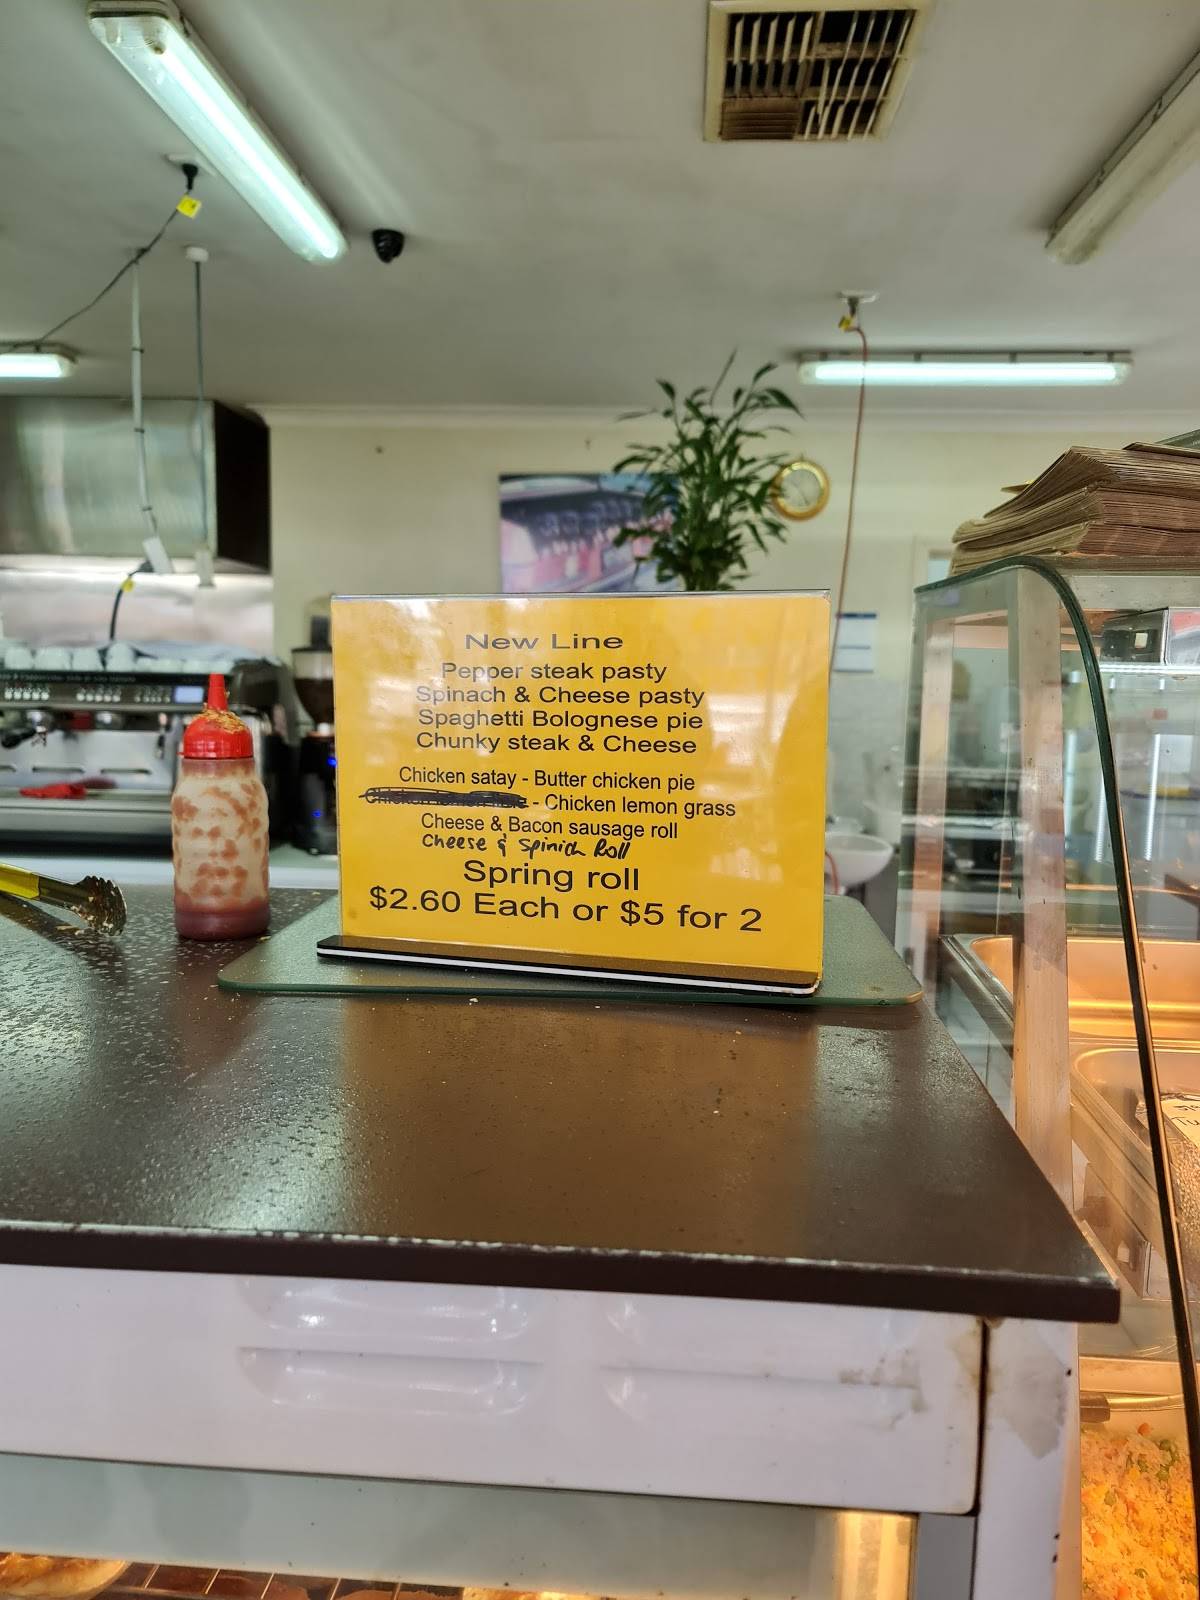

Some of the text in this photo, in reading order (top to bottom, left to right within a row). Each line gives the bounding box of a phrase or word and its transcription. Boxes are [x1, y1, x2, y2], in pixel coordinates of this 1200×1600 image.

[465, 634, 623, 649] New Line
[442, 662, 667, 683] Pepper steak pasty
[416, 686, 705, 708] Spinach & Cheese pasty
[418, 709, 703, 732] Spaghetti Bolognese pie
[416, 732, 697, 753] Chunky steak & Cheese
[399, 766, 465, 784] Chicken
[471, 771, 516, 788] satay
[534, 770, 587, 788] Butter
[592, 772, 661, 790] chicken
[667, 774, 695, 791] pie
[545, 794, 616, 812] Chicken
[622, 797, 678, 815] lemon
[684, 803, 736, 818] grass
[421, 813, 678, 840] Cheese & Bacon sausage roll
[422, 833, 488, 851] Cheese
[593, 838, 631, 860] Roll
[463, 860, 640, 892] Spring roll
[369, 886, 762, 931] $2.60 Each or $5 for 2
